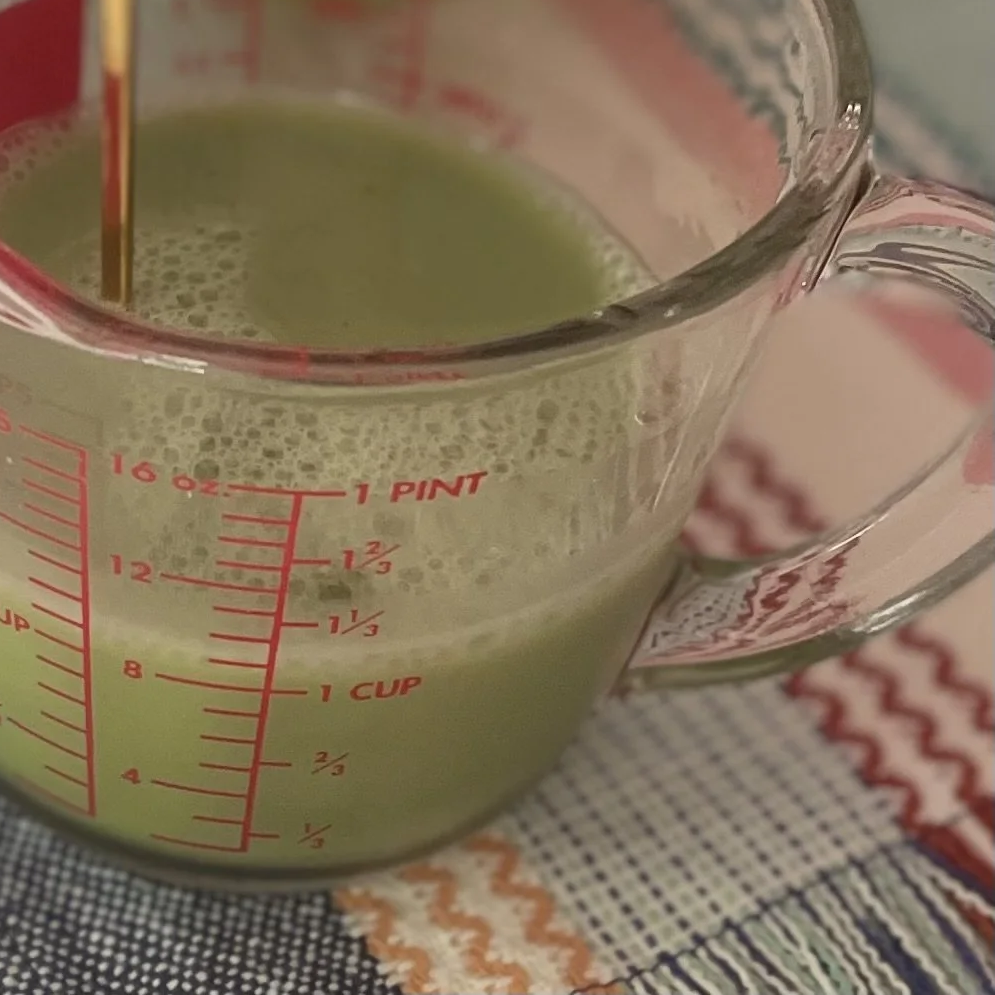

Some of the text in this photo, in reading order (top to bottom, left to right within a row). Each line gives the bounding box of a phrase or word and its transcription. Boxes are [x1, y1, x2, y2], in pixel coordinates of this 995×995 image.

[111, 452, 158, 483] 16
[355, 470, 488, 505] 1 PINT
[111, 555, 153, 583] 12
[123, 660, 143, 679] 8
[320, 676, 422, 702] 1 CUP
[121, 768, 140, 785] 4
[311, 751, 349, 776] 2/3
